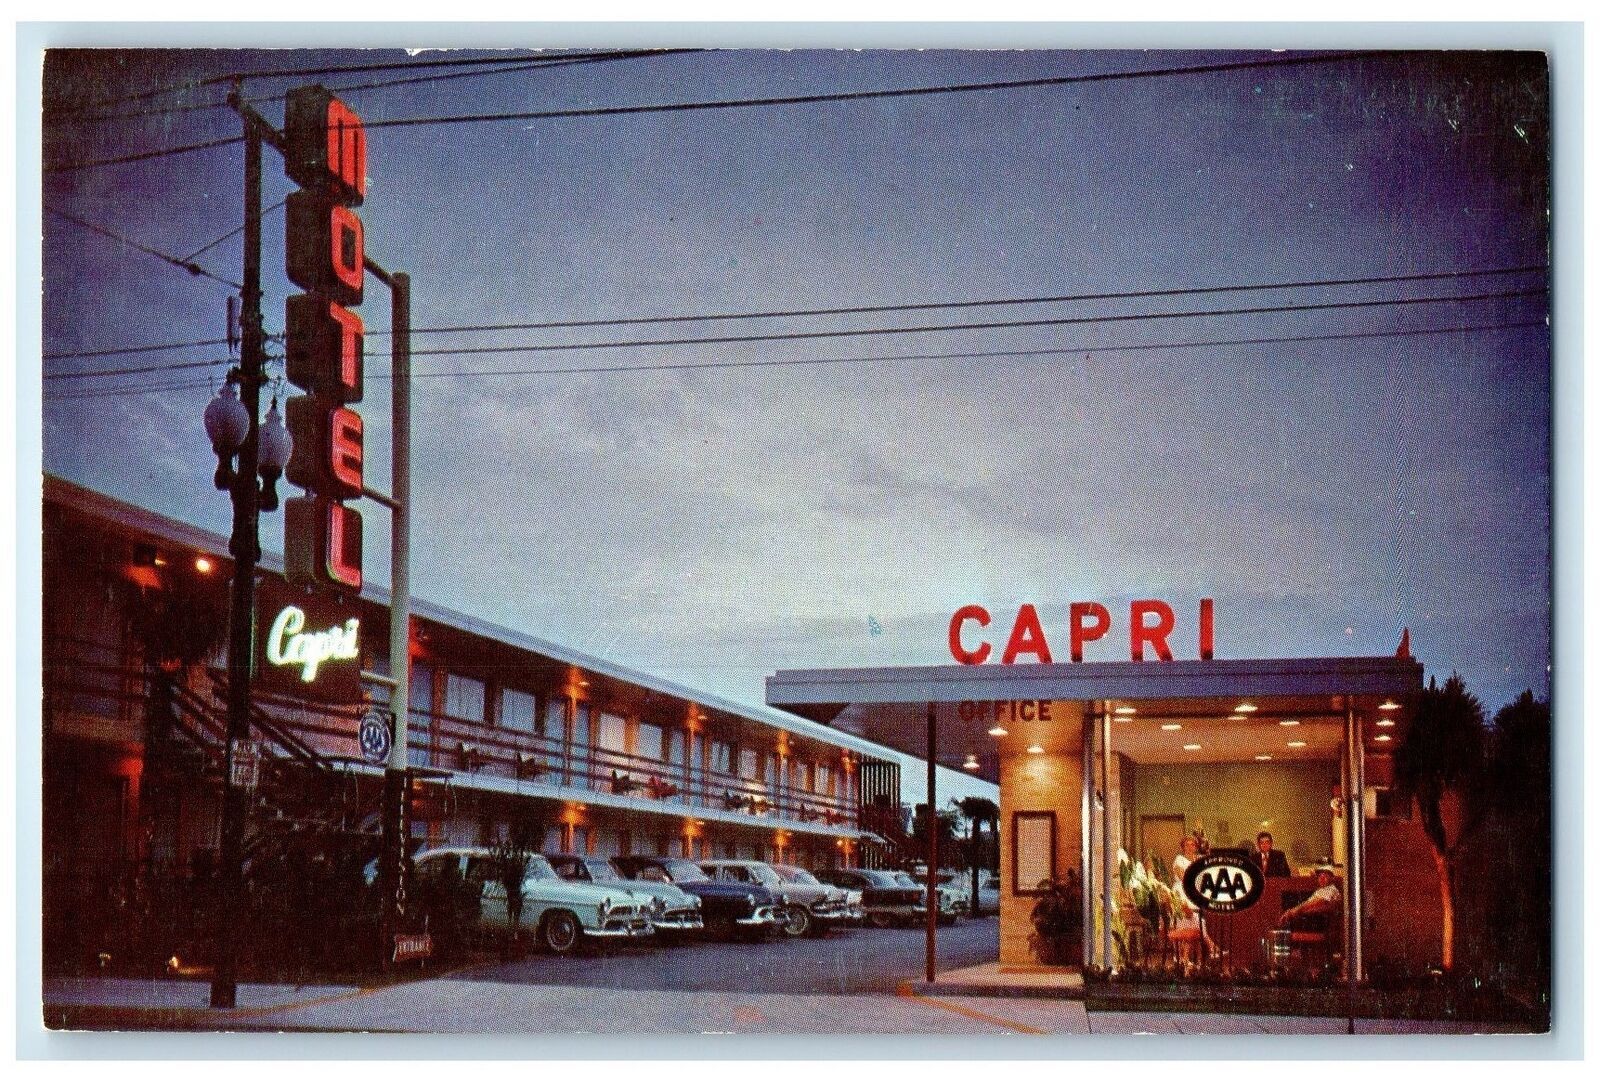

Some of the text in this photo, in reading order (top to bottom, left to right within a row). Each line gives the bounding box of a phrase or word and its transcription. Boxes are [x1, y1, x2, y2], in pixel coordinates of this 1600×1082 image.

[327, 100, 365, 587] MOTEL
[266, 605, 360, 683] Capri
[948, 598, 1214, 665] CAPRI
[958, 700, 1052, 722] OFFICE
[1201, 868, 1247, 899] AAA
